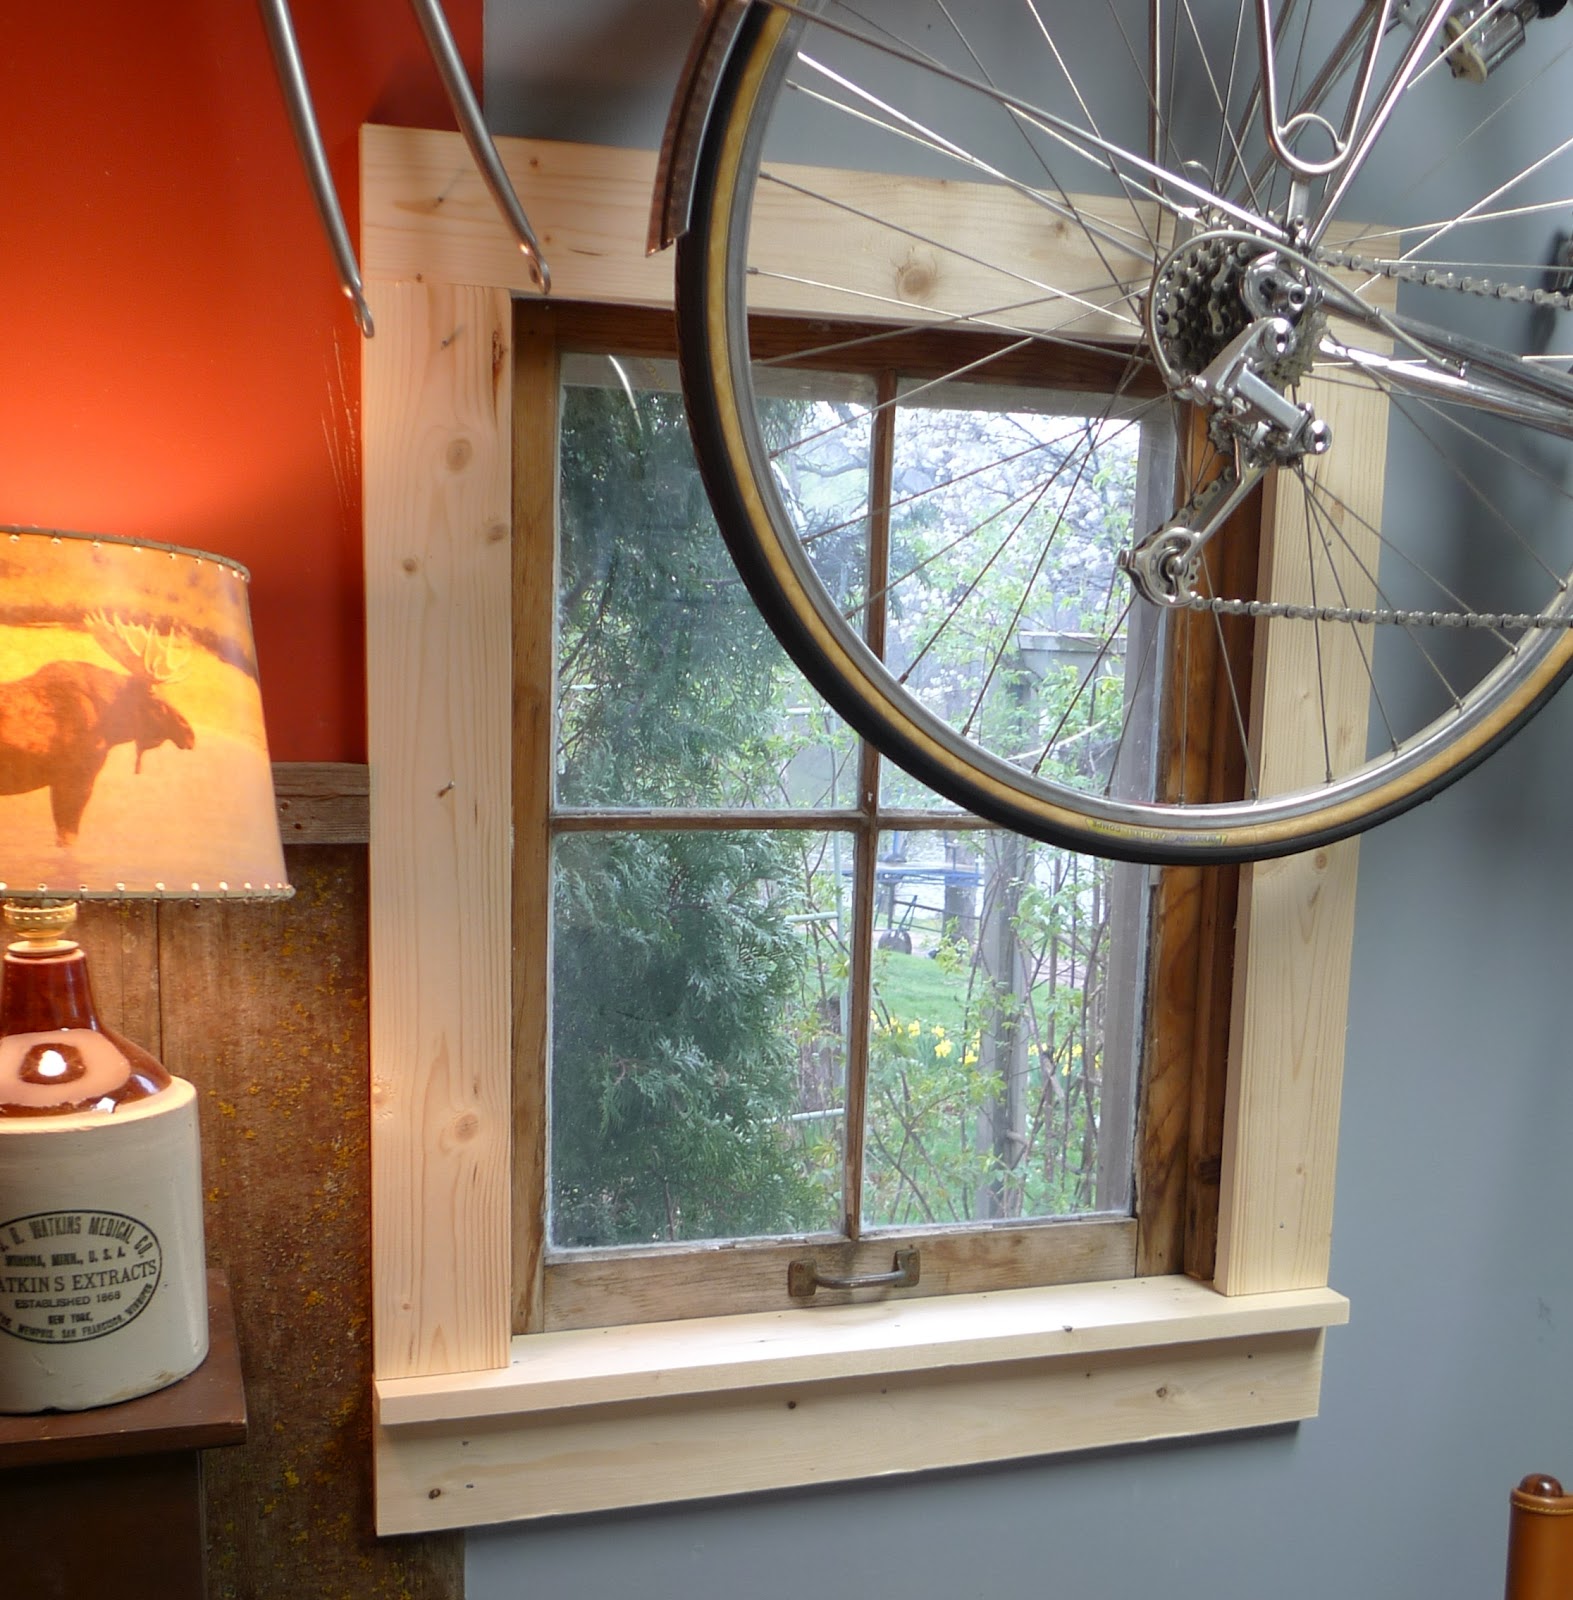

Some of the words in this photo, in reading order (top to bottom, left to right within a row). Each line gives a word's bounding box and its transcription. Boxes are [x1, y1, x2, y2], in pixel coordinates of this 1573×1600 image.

[29, 1216, 81, 1239] WATKINS
[88, 1216, 136, 1244] MEDICAL
[72, 1259, 157, 1290] EXTRACTS
[15, 1296, 91, 1309] ESTABLISHED
[96, 1290, 121, 1303] 1868
